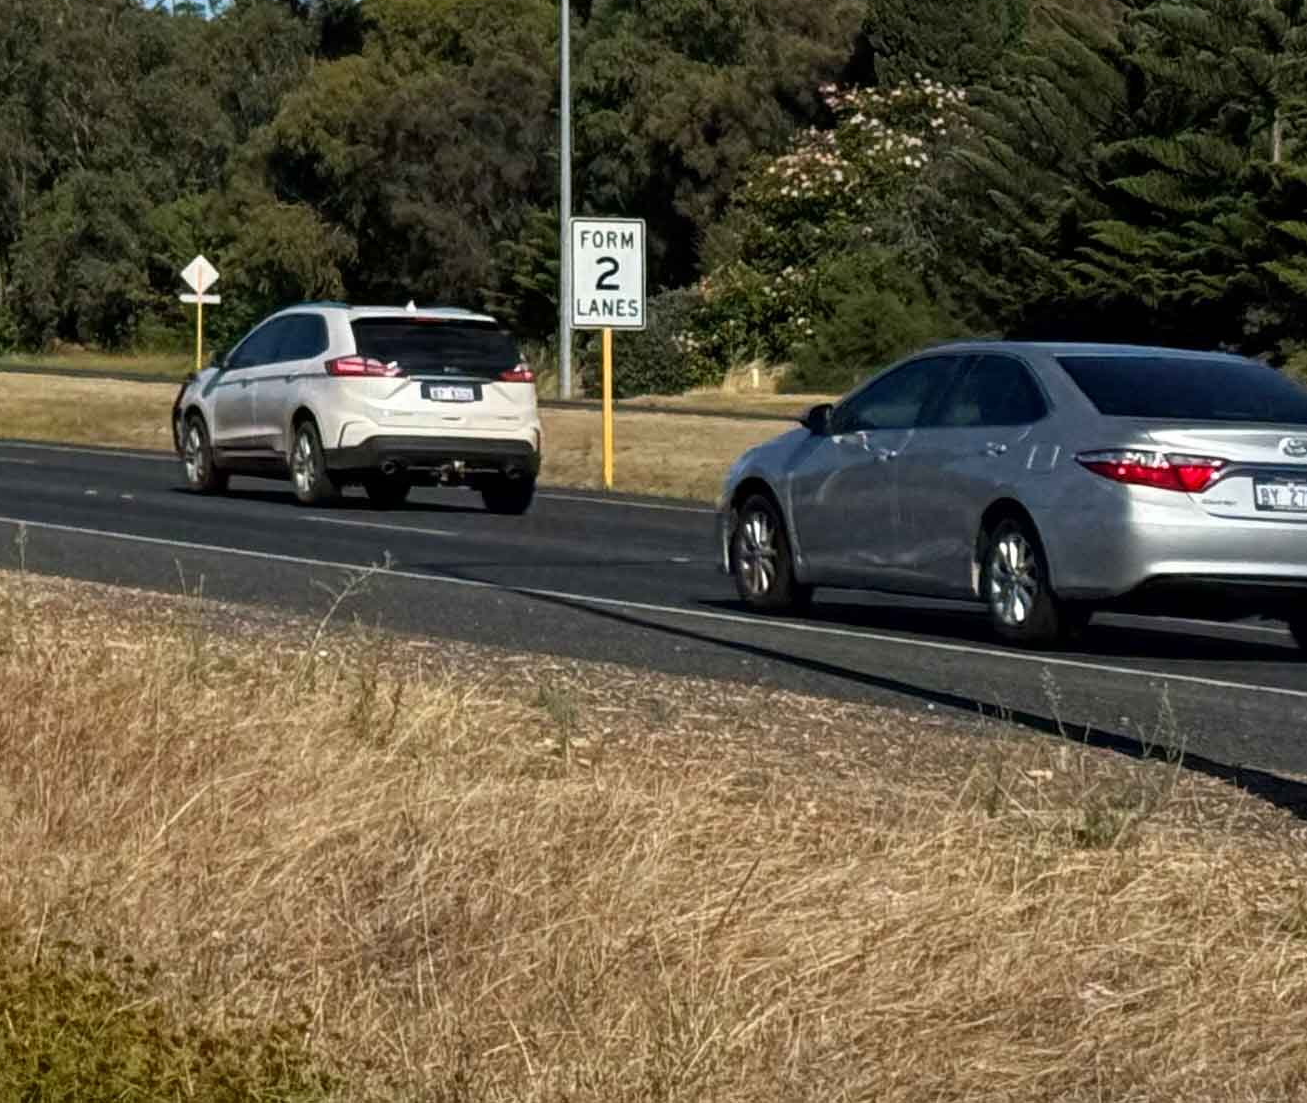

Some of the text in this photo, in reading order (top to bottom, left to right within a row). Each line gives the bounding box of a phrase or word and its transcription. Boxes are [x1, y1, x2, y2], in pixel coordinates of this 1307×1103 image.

[580, 230, 634, 249] FORM
[596, 256, 620, 290] 2
[577, 299, 639, 317] LANES
